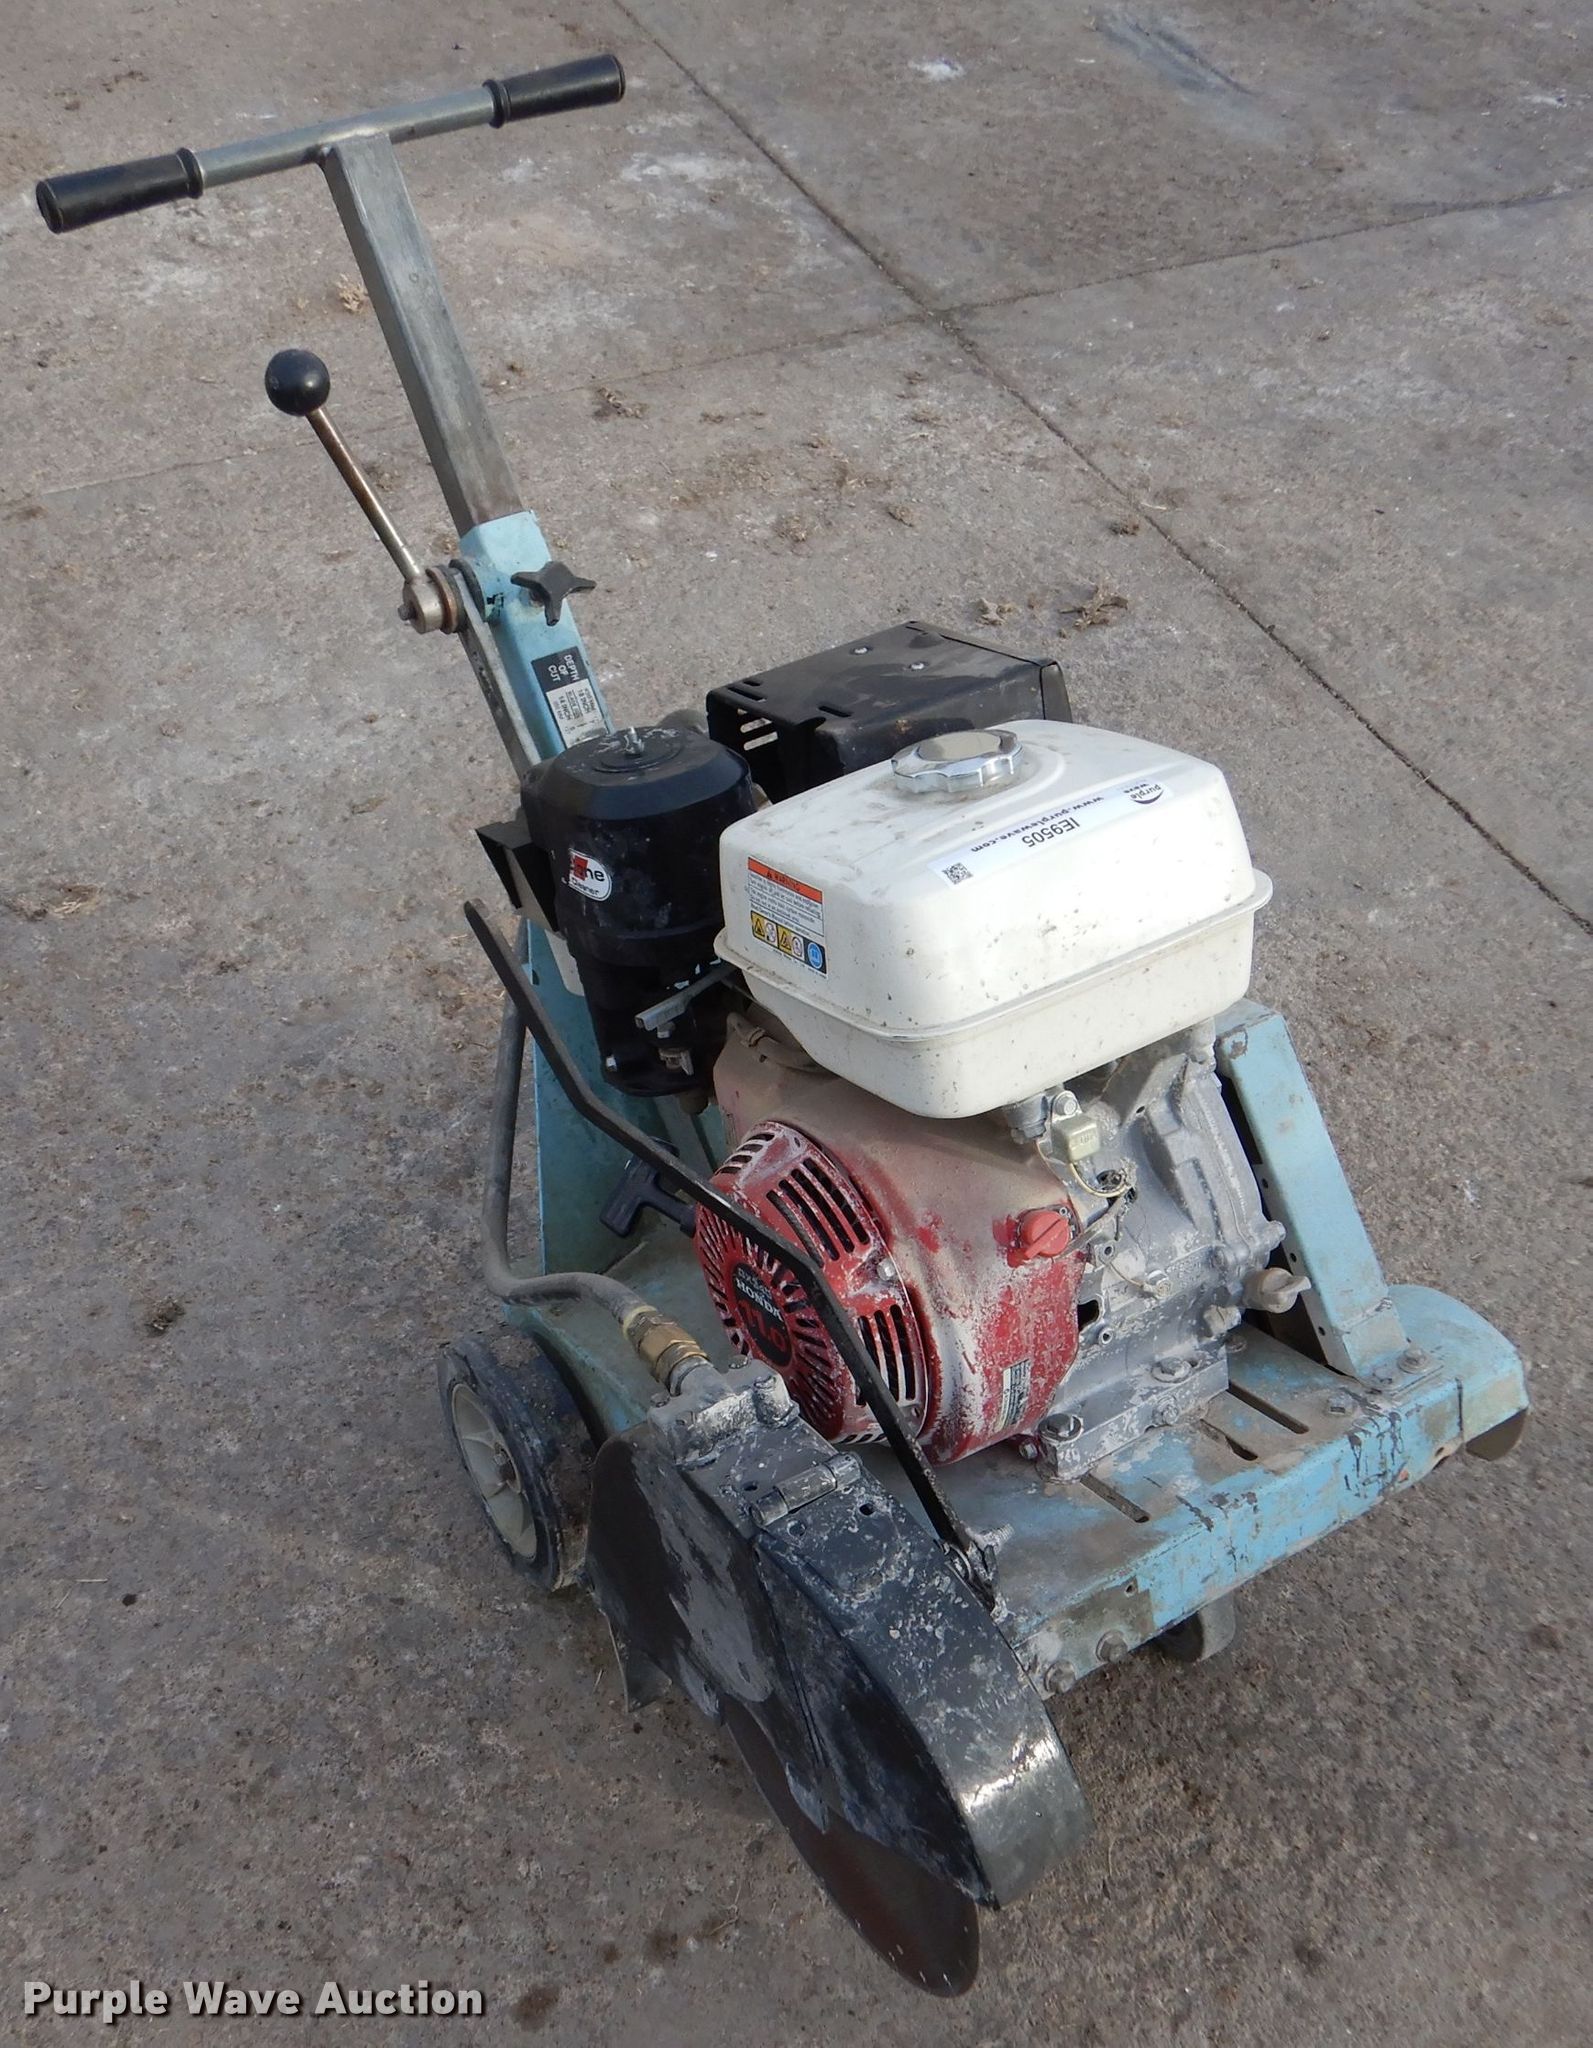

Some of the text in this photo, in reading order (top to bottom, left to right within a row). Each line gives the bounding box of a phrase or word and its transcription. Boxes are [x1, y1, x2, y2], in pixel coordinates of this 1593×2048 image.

[548, 665, 561, 682] CUT
[558, 665, 569, 676] OF
[564, 654, 580, 681] DEPTH
[1129, 782, 1162, 801] purple
[970, 796, 1104, 852] www.purplewave.com
[1021, 817, 1080, 848] IE9505
[736, 1279, 784, 1323] HONDA
